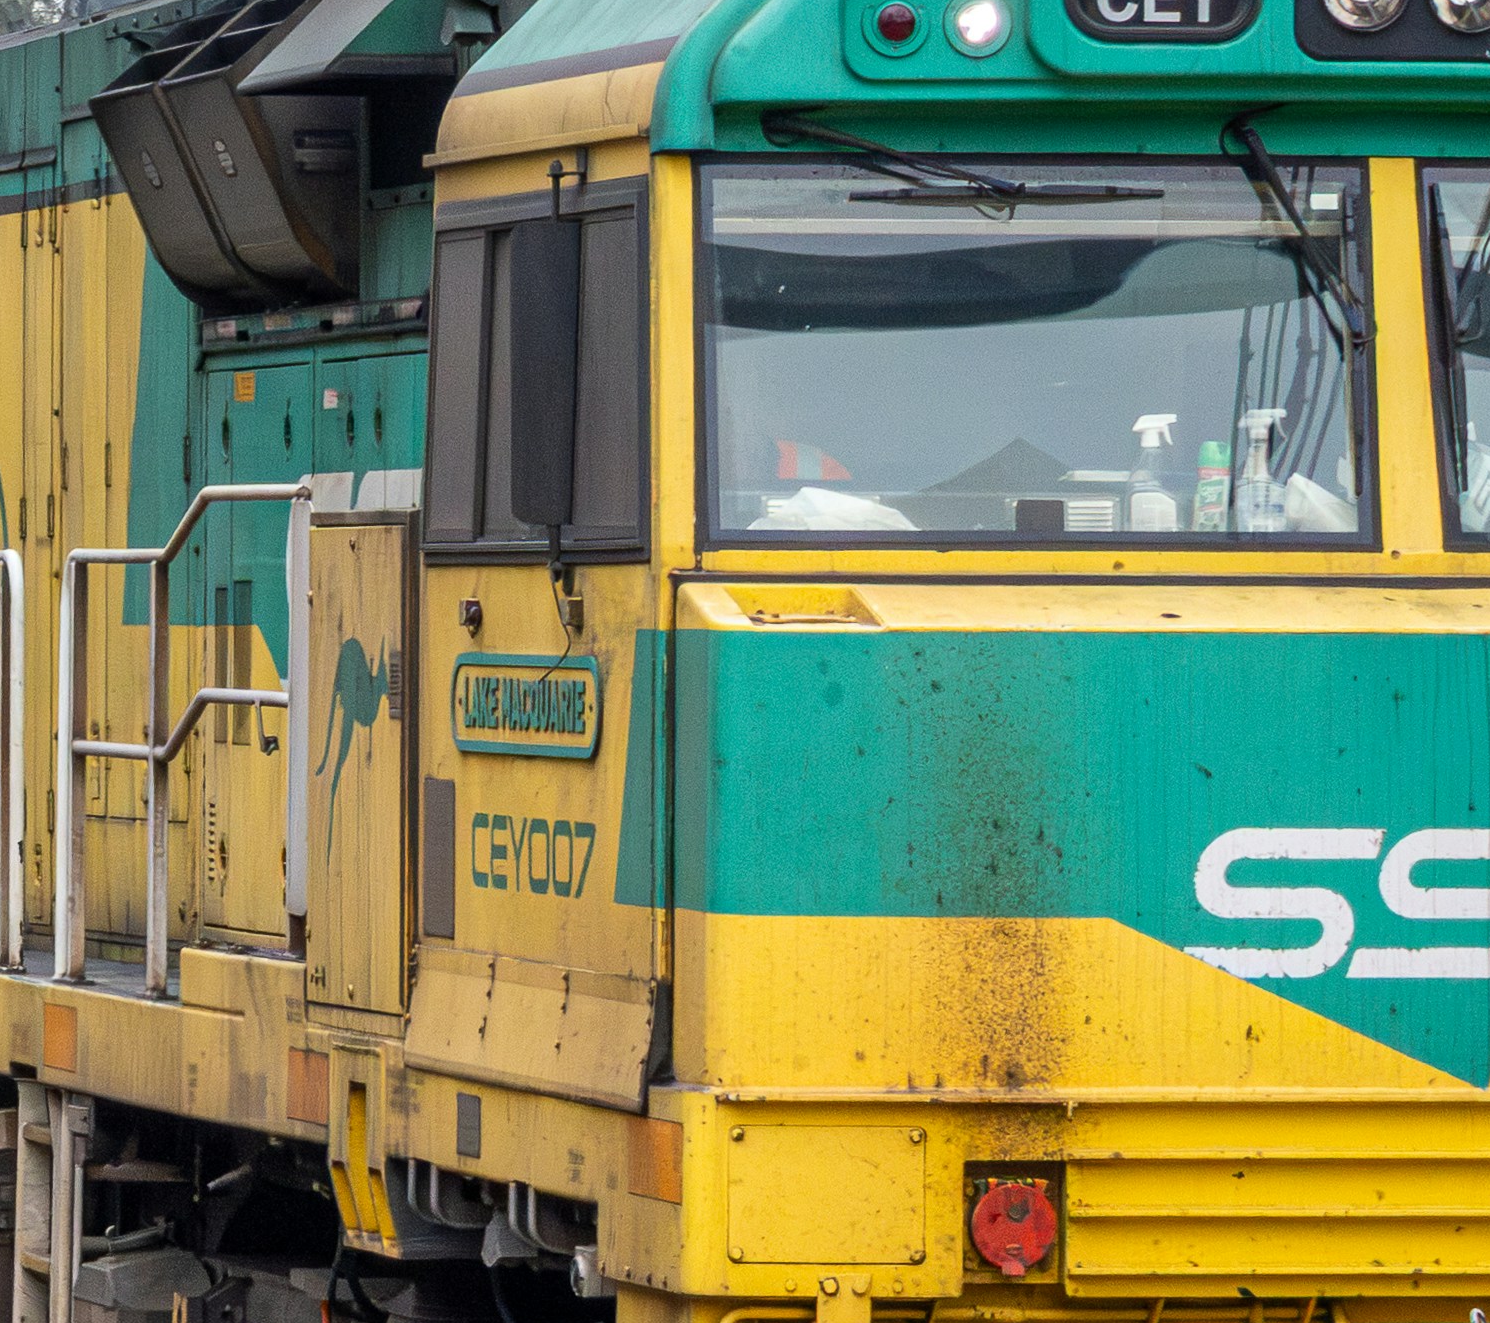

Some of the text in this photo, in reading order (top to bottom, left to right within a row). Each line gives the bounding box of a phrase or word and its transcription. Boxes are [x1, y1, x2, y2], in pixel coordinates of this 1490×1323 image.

[463, 675, 588, 736] LAKE MACQUARIE
[471, 811, 597, 900] CEY007
